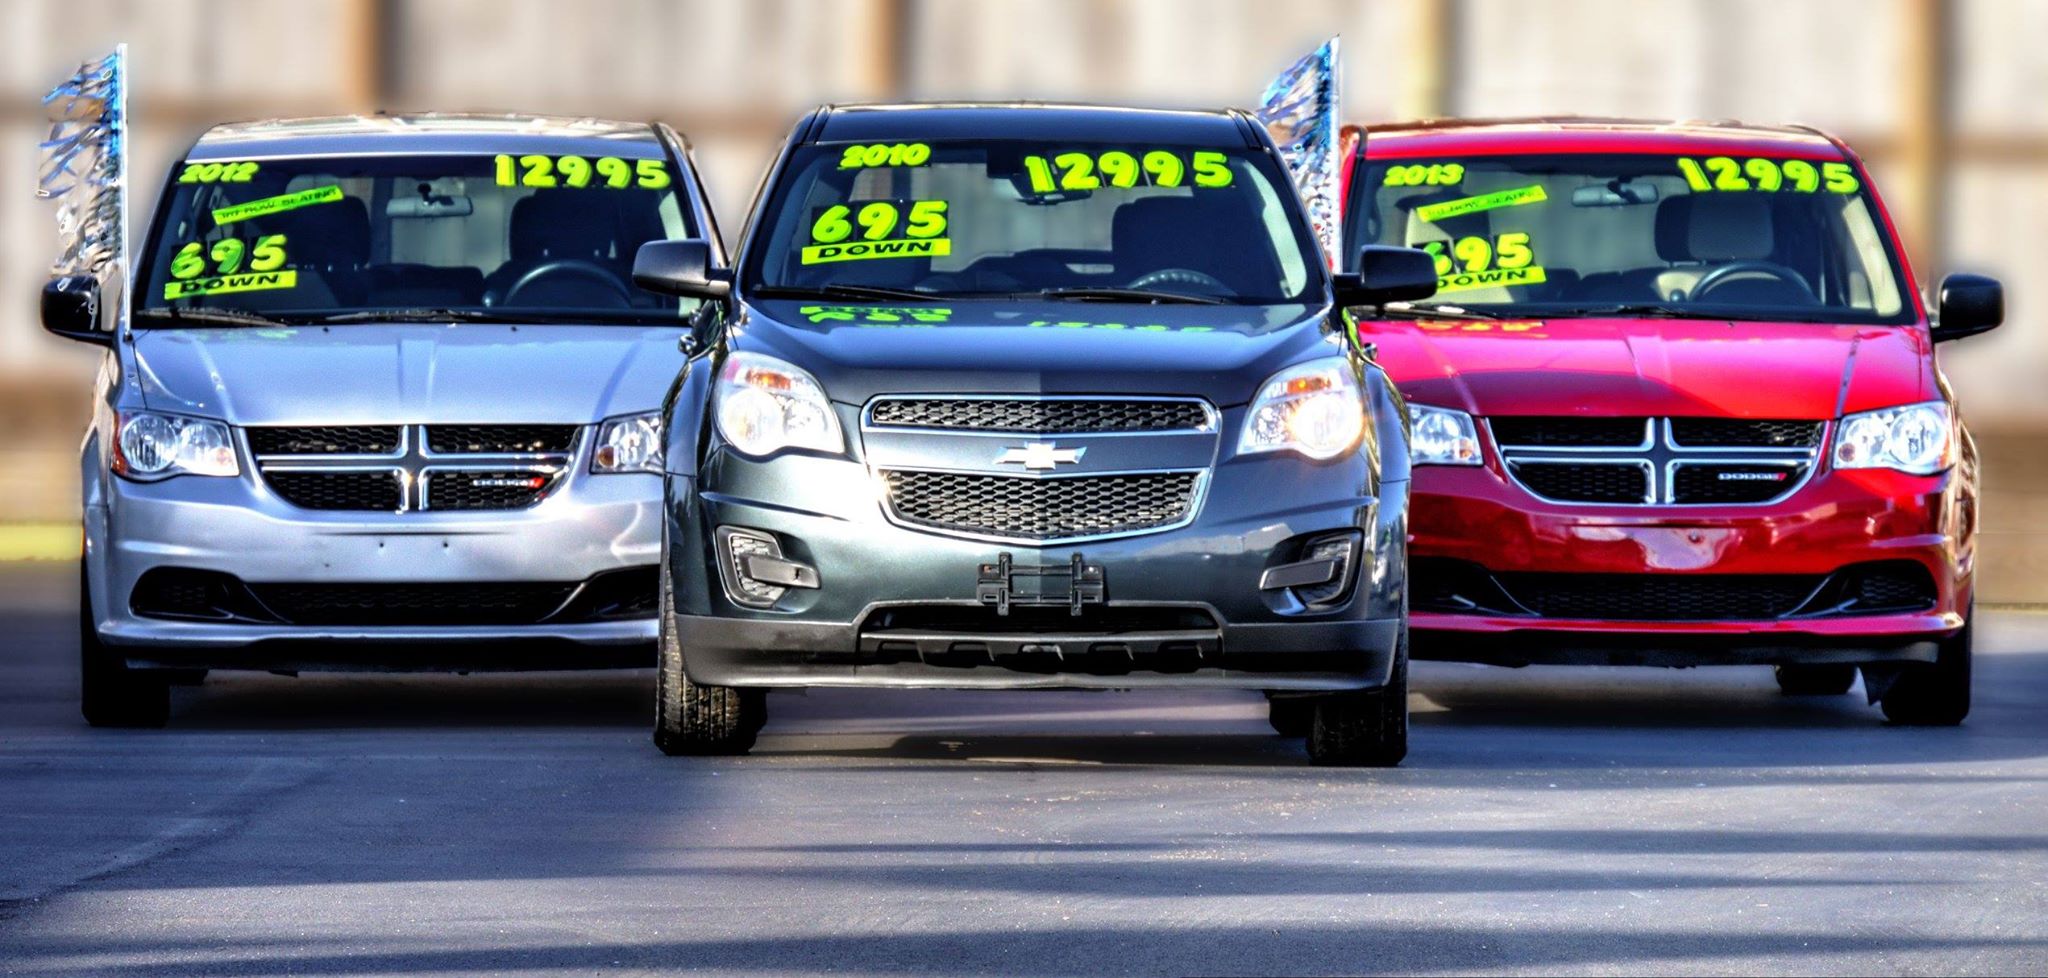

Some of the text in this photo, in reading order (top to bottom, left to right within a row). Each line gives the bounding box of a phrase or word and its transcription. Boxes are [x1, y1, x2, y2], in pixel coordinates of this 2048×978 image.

[840, 143, 931, 168] 2010
[179, 162, 259, 183] 2012
[495, 154, 671, 189] 12995
[1025, 151, 1233, 192] 12995
[1384, 163, 1464, 186] 2013
[1677, 157, 1860, 194] 12995
[812, 200, 948, 243] 695
[171, 234, 287, 279] 695
[818, 242, 932, 258] DOWN
[180, 274, 279, 293] DOWN
[1718, 472, 1777, 481] DODGE
